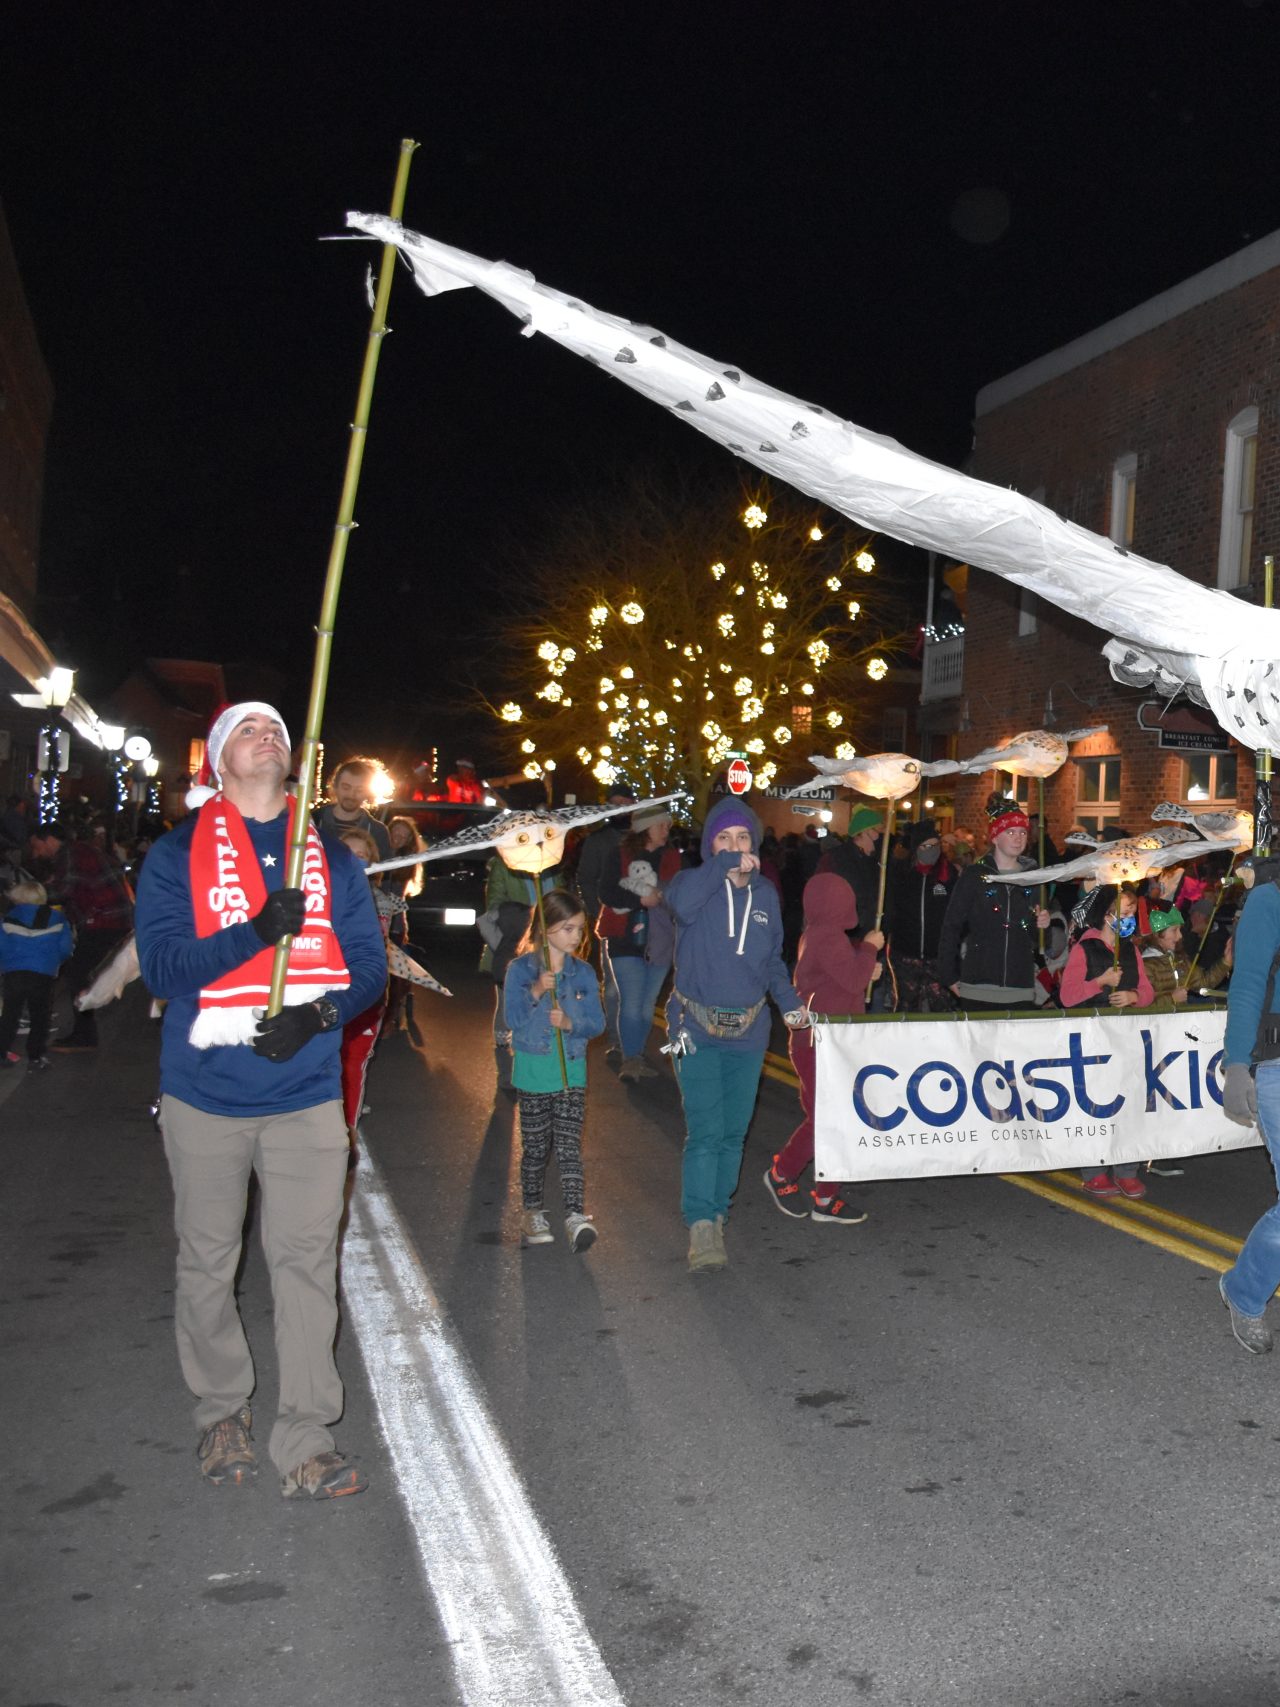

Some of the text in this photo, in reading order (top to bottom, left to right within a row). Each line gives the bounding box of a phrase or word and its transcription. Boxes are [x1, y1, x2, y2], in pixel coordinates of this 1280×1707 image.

[730, 770, 747, 784] STOP
[291, 937, 322, 950] MC
[853, 1032, 1126, 1132] coast
[858, 1124, 1117, 1147] ASSATEAGUE COASTAL TRUST
